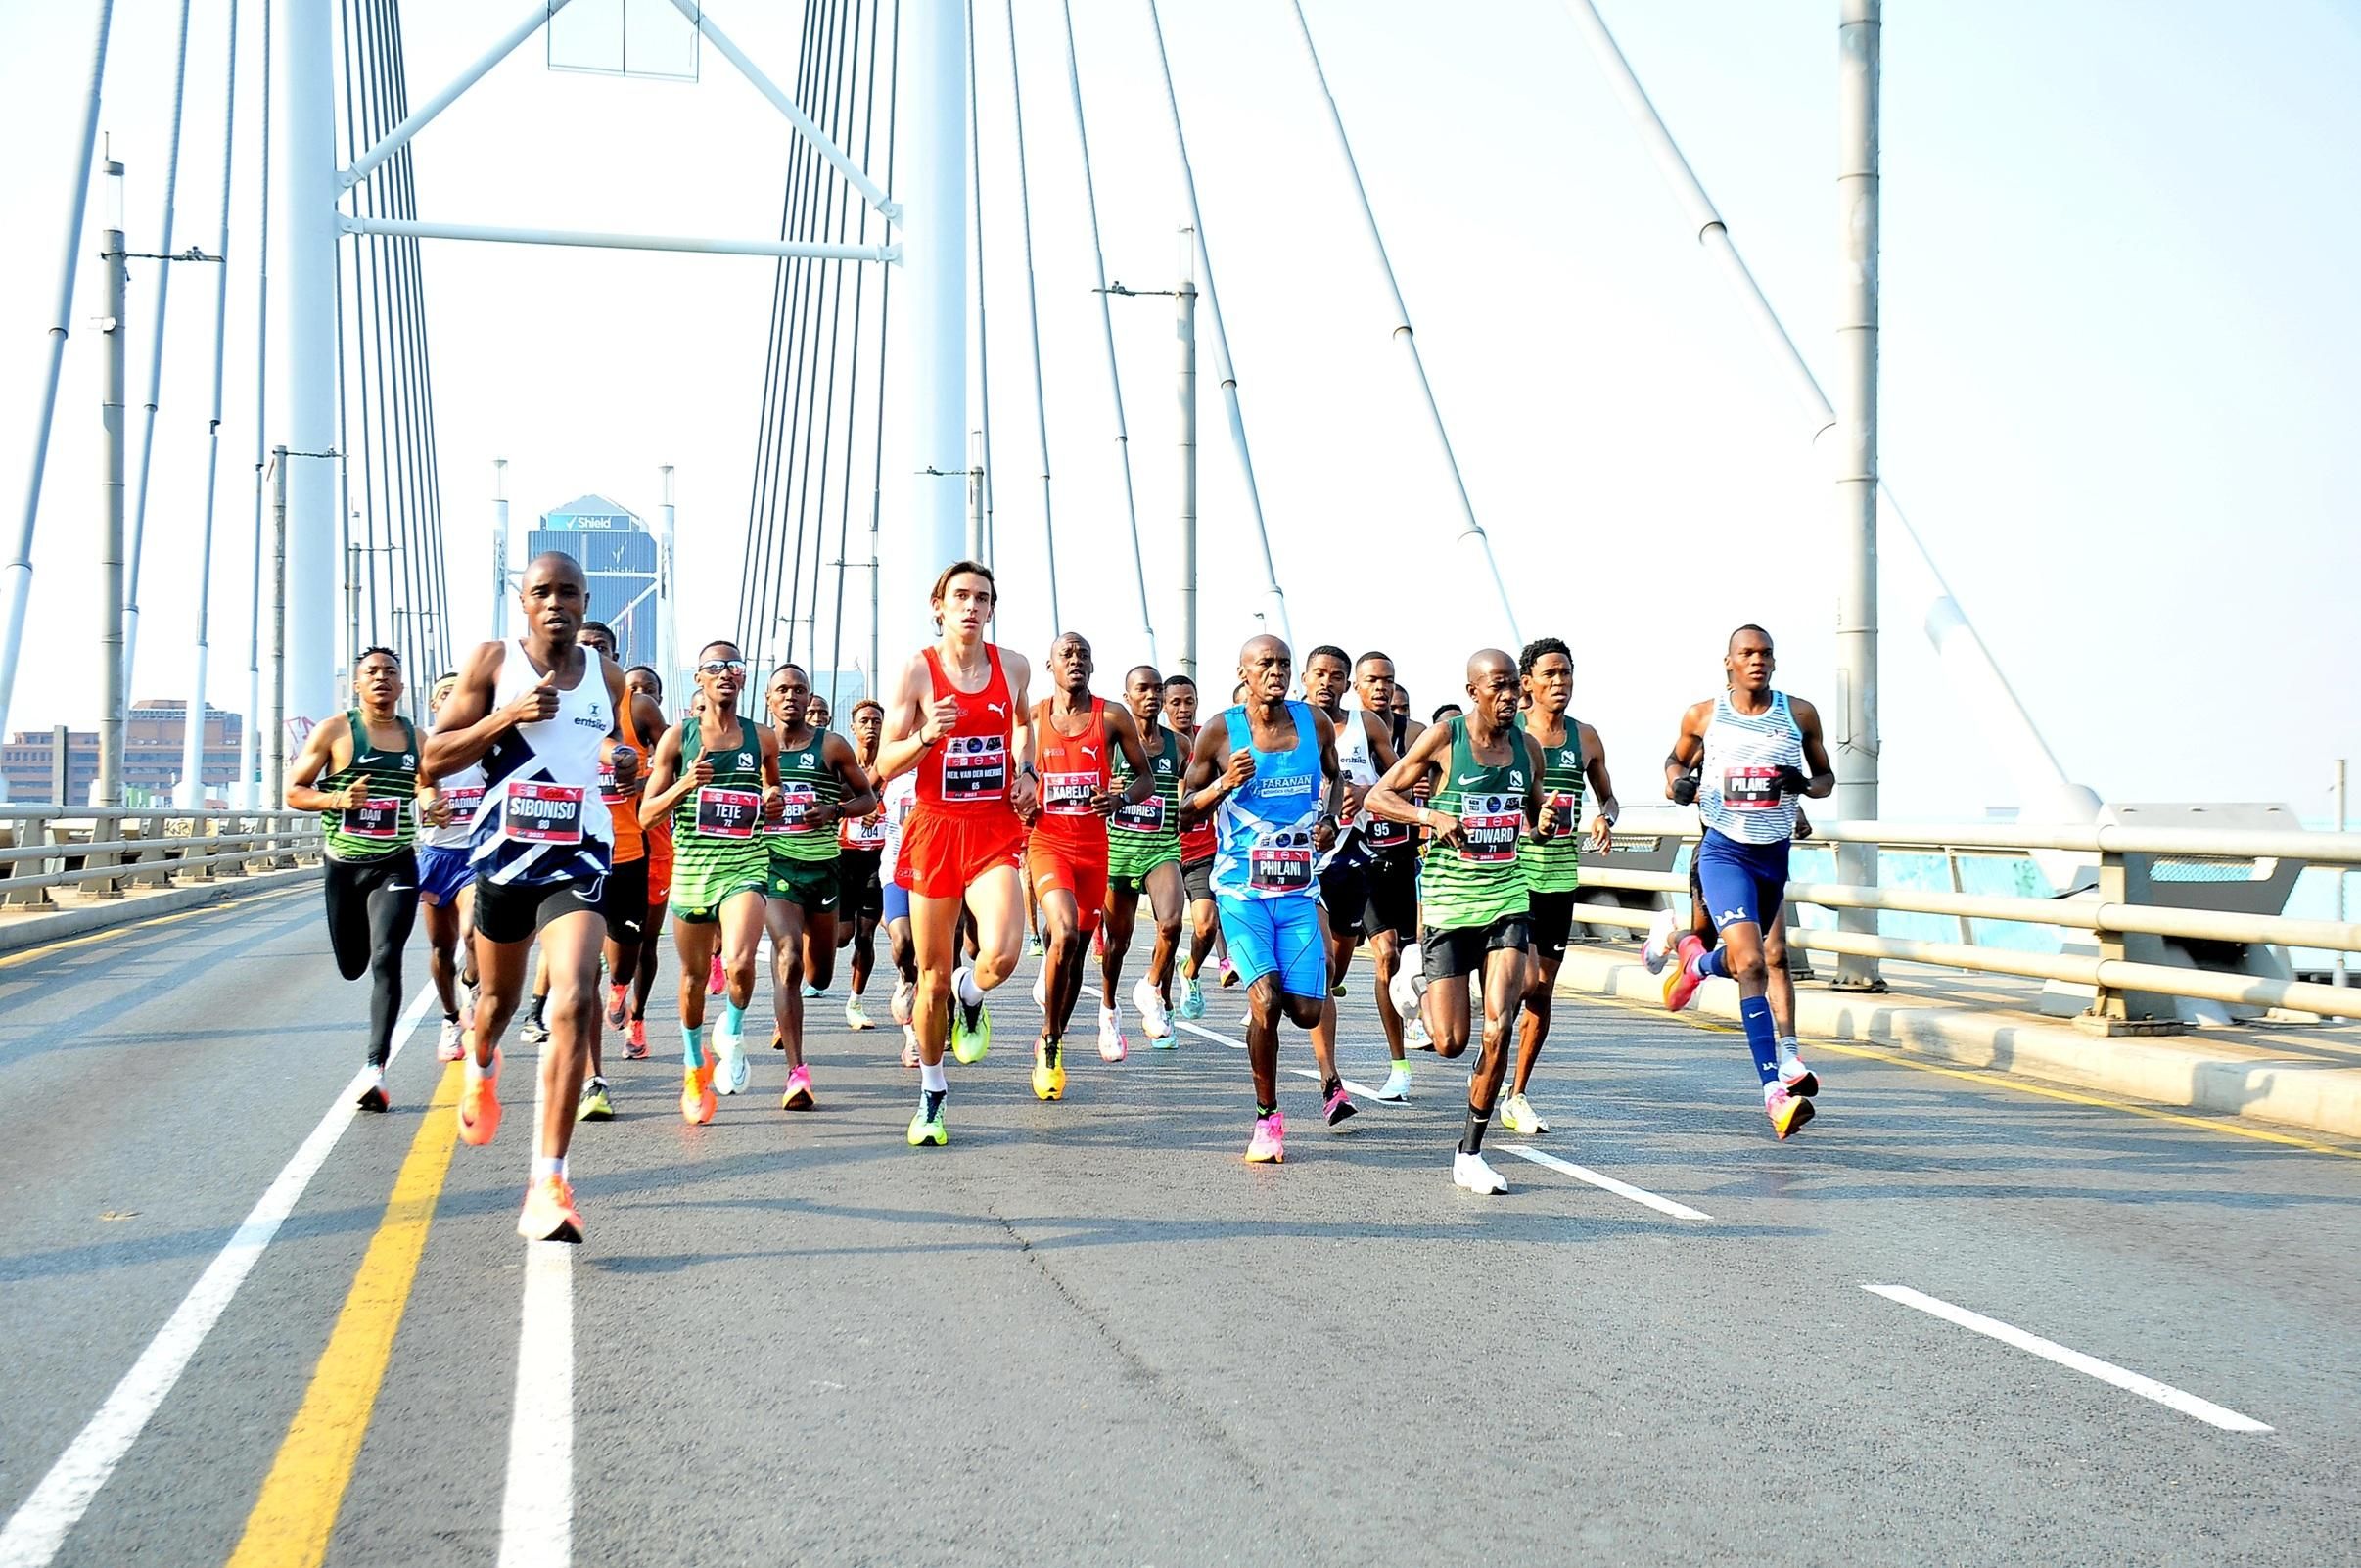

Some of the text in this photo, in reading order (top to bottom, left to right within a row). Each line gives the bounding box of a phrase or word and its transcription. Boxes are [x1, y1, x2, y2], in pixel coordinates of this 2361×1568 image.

[578, 516, 612, 529] Shield
[960, 770, 972, 779] VAN
[973, 769, 984, 778] DER
[1052, 785, 1089, 799] KABELO
[360, 808, 382, 821] DAN
[510, 797, 576, 820] SIBONISO
[715, 803, 742, 819] TETE
[723, 818, 733, 827] 72
[1374, 823, 1390, 836] 95
[861, 825, 879, 839] 204
[1468, 827, 1515, 844] EDWARD
[1260, 861, 1301, 876] PHILANI
